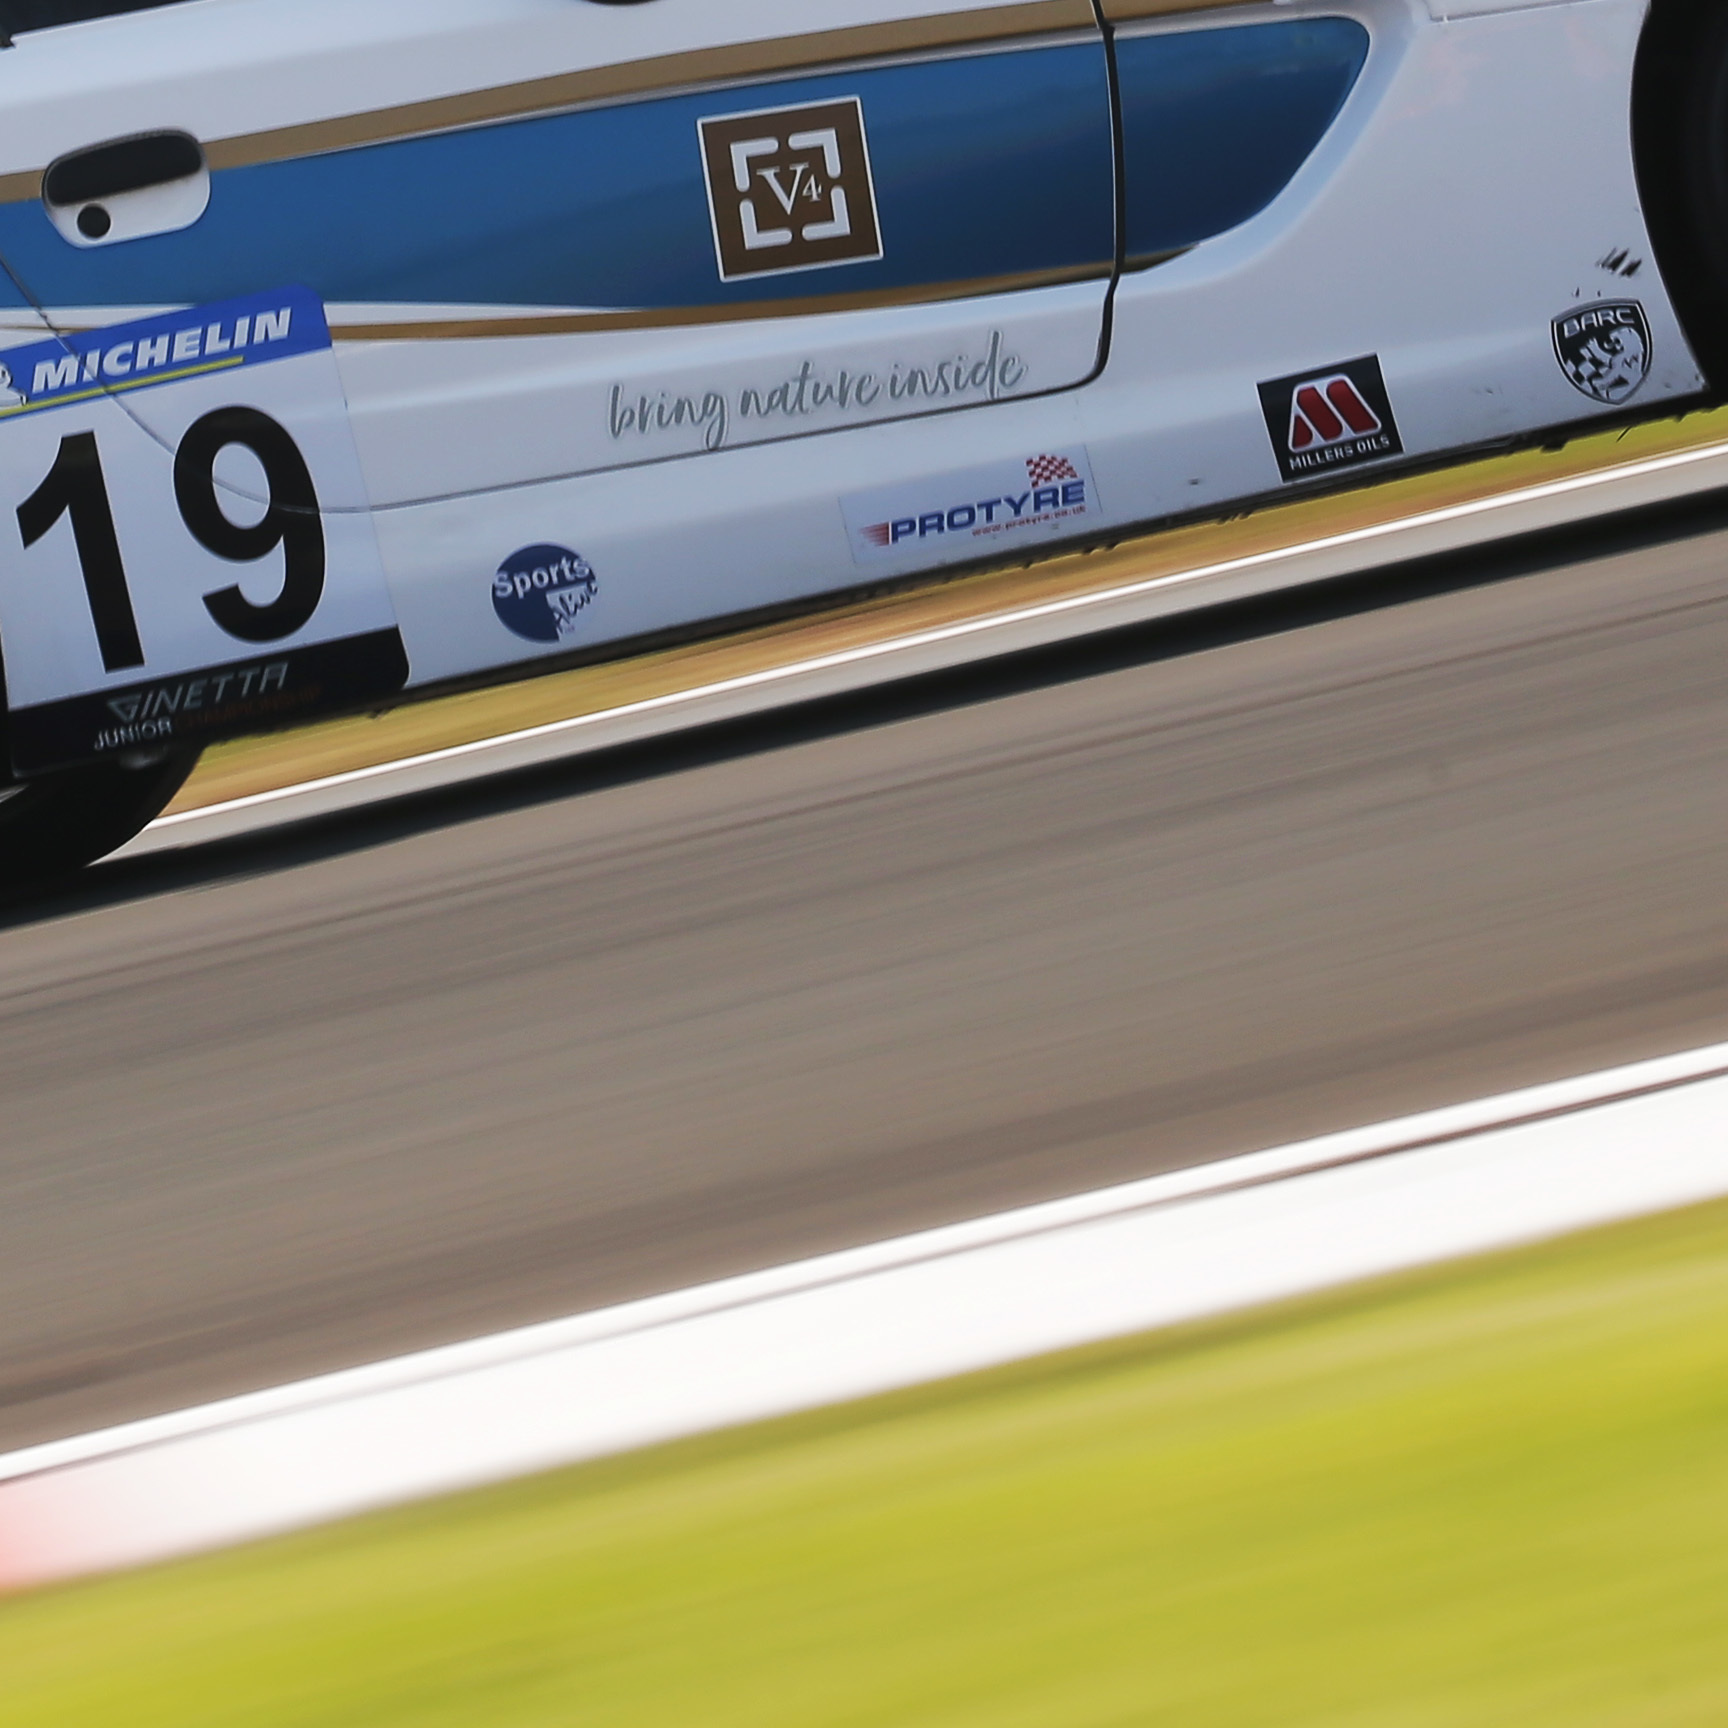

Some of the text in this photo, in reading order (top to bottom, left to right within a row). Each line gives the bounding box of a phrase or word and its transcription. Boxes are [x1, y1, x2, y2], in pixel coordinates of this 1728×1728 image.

[756, 162, 822, 215] V4
[31, 306, 292, 394] MICHELIN
[609, 330, 1029, 450] bring nature inside
[1289, 434, 1390, 471] MILLERS OILS
[15, 404, 326, 674] 19
[889, 479, 1085, 545] PROTYRE
[972, 504, 1086, 536] www.protyre.co.uk
[494, 556, 590, 600] Sports
[106, 660, 290, 723] GINETTA
[94, 715, 173, 752] JUNIOR
